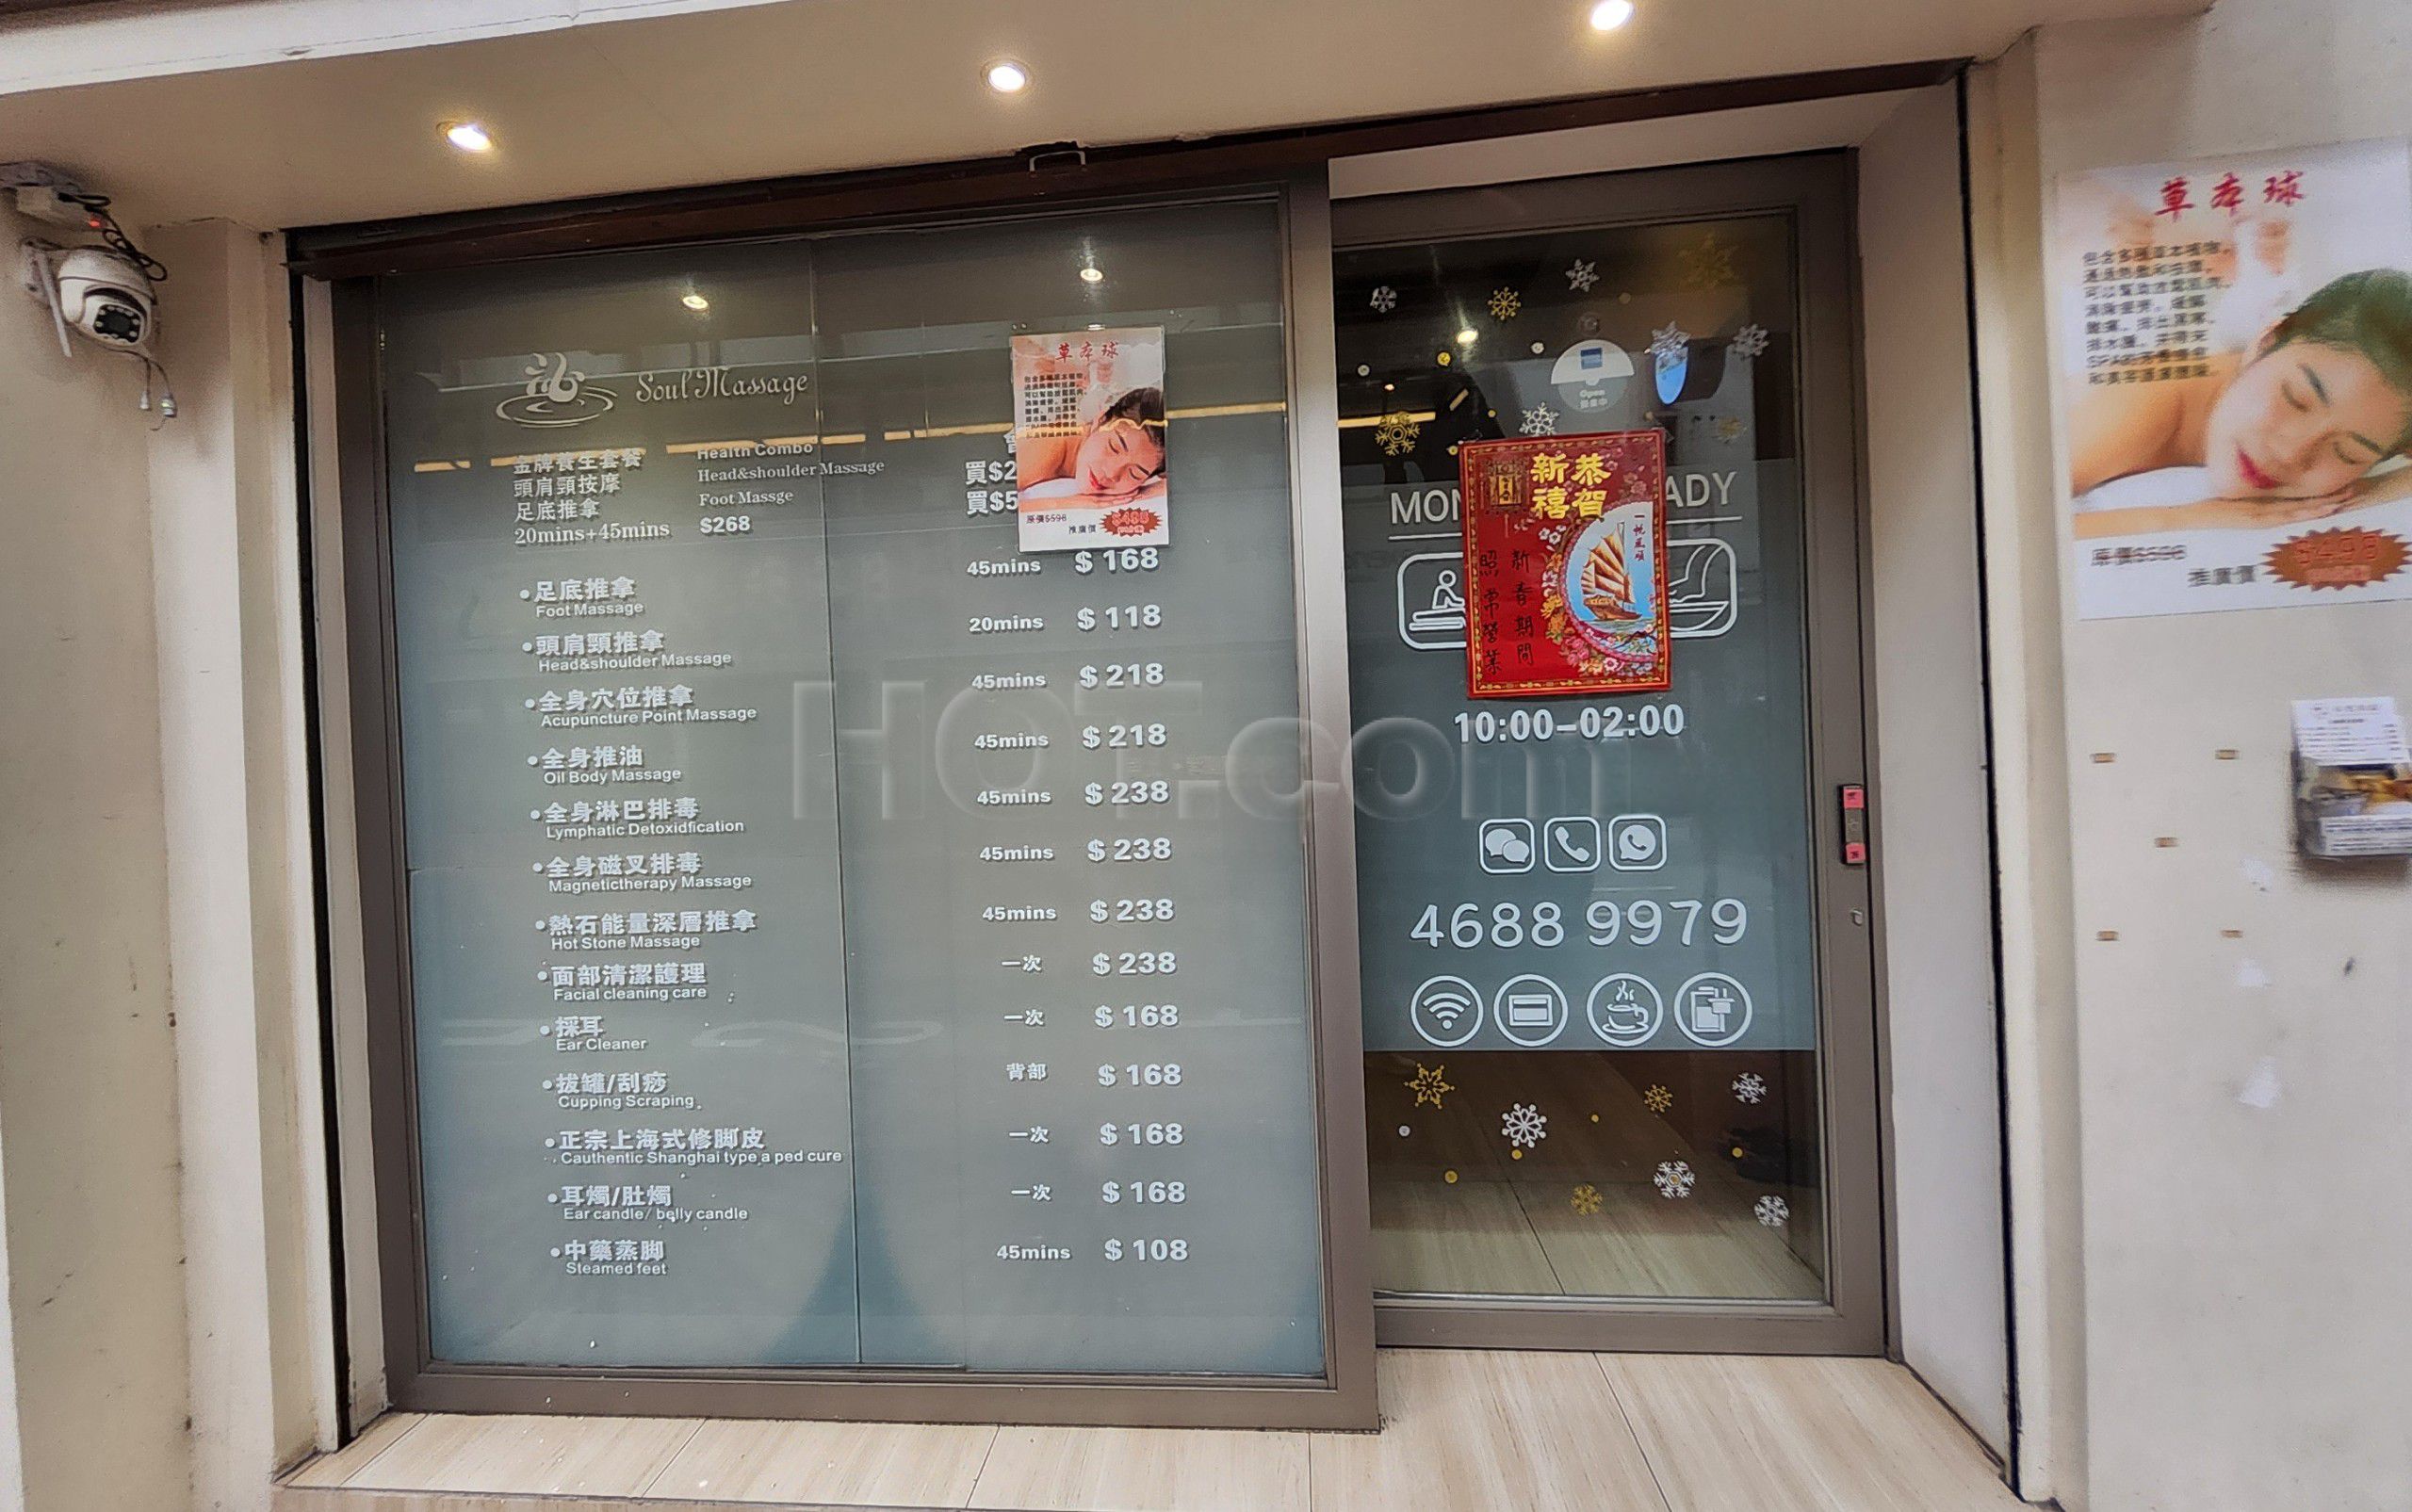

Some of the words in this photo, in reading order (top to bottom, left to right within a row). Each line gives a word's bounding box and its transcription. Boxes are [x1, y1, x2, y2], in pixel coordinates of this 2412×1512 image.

[636, 371, 690, 403] Soul
[694, 366, 808, 406] Massage
[755, 443, 814, 457] Combo
[698, 464, 817, 482] Head&shoulder
[819, 460, 885, 476] Massage
[513, 472, 620, 497] 頭肩頸按摩
[699, 493, 739, 507] Foot
[739, 491, 793, 505] Massge
[514, 497, 600, 522] 足底推拿
[513, 520, 671, 545] 20mins+45mins
[700, 515, 751, 534] $268
[967, 559, 1041, 576] 45mins
[534, 577, 636, 602] 足底推拿
[536, 605, 571, 618] Foot
[574, 601, 644, 616] Massage
[970, 614, 1044, 632] 20mins
[535, 629, 664, 657] 頭肩頸推拿
[538, 657, 659, 672] Head&shoulder
[661, 652, 732, 668] Massage
[971, 672, 1047, 689] 45mins
[538, 684, 693, 712] 全身穴位推拿
[541, 711, 639, 728] Acupuncture
[642, 709, 683, 723] Point
[686, 707, 757, 723] Massage
[974, 732, 1049, 749] 45mins
[541, 744, 644, 770] 全身推油
[544, 771, 565, 785] Oil
[569, 770, 608, 785] Body
[612, 768, 681, 783] Massage
[977, 789, 1051, 805] 45mins
[544, 796, 699, 824] 全身淋巴排毒
[546, 822, 626, 840] Lymphatic
[979, 845, 1054, 861] 45mins
[549, 877, 677, 894] Magnetictherapy
[681, 875, 752, 889] Massage
[982, 905, 1057, 921] 45mins
[1410, 901, 1565, 948] 4688
[1586, 898, 1749, 947] 9979
[551, 936, 578, 951] Hot
[581, 935, 627, 950] Stone
[630, 935, 700, 950] Massage
[1001, 954, 1042, 972] 一次
[550, 962, 707, 987] 面部清潔護理
[554, 987, 600, 1001] Facial
[604, 986, 669, 1002] cleaning
[672, 987, 707, 999] care
[1003, 1008, 1044, 1026] 一次
[555, 1016, 604, 1038] 採耳
[556, 1038, 584, 1051] Ear
[586, 1038, 647, 1050] Cleaner
[1006, 1063, 1047, 1081] 背部
[556, 1071, 667, 1095] 拔罐/刮痧
[559, 1096, 622, 1111] Cupping
[626, 1095, 694, 1110] Scraping
[1009, 1126, 1049, 1144] 一次
[561, 1151, 644, 1164] Cauthentic
[646, 1150, 719, 1166] Shanghai
[724, 1151, 758, 1165] type
[774, 1149, 804, 1164] ped
[807, 1150, 842, 1162] cure
[1011, 1183, 1051, 1201] 一次
[563, 1208, 591, 1221] Ear
[656, 1207, 692, 1223] belly
[696, 1206, 749, 1220] candle
[996, 1244, 1071, 1260] 45mins
[566, 1261, 633, 1276] Steamed
[637, 1262, 668, 1275] feet
